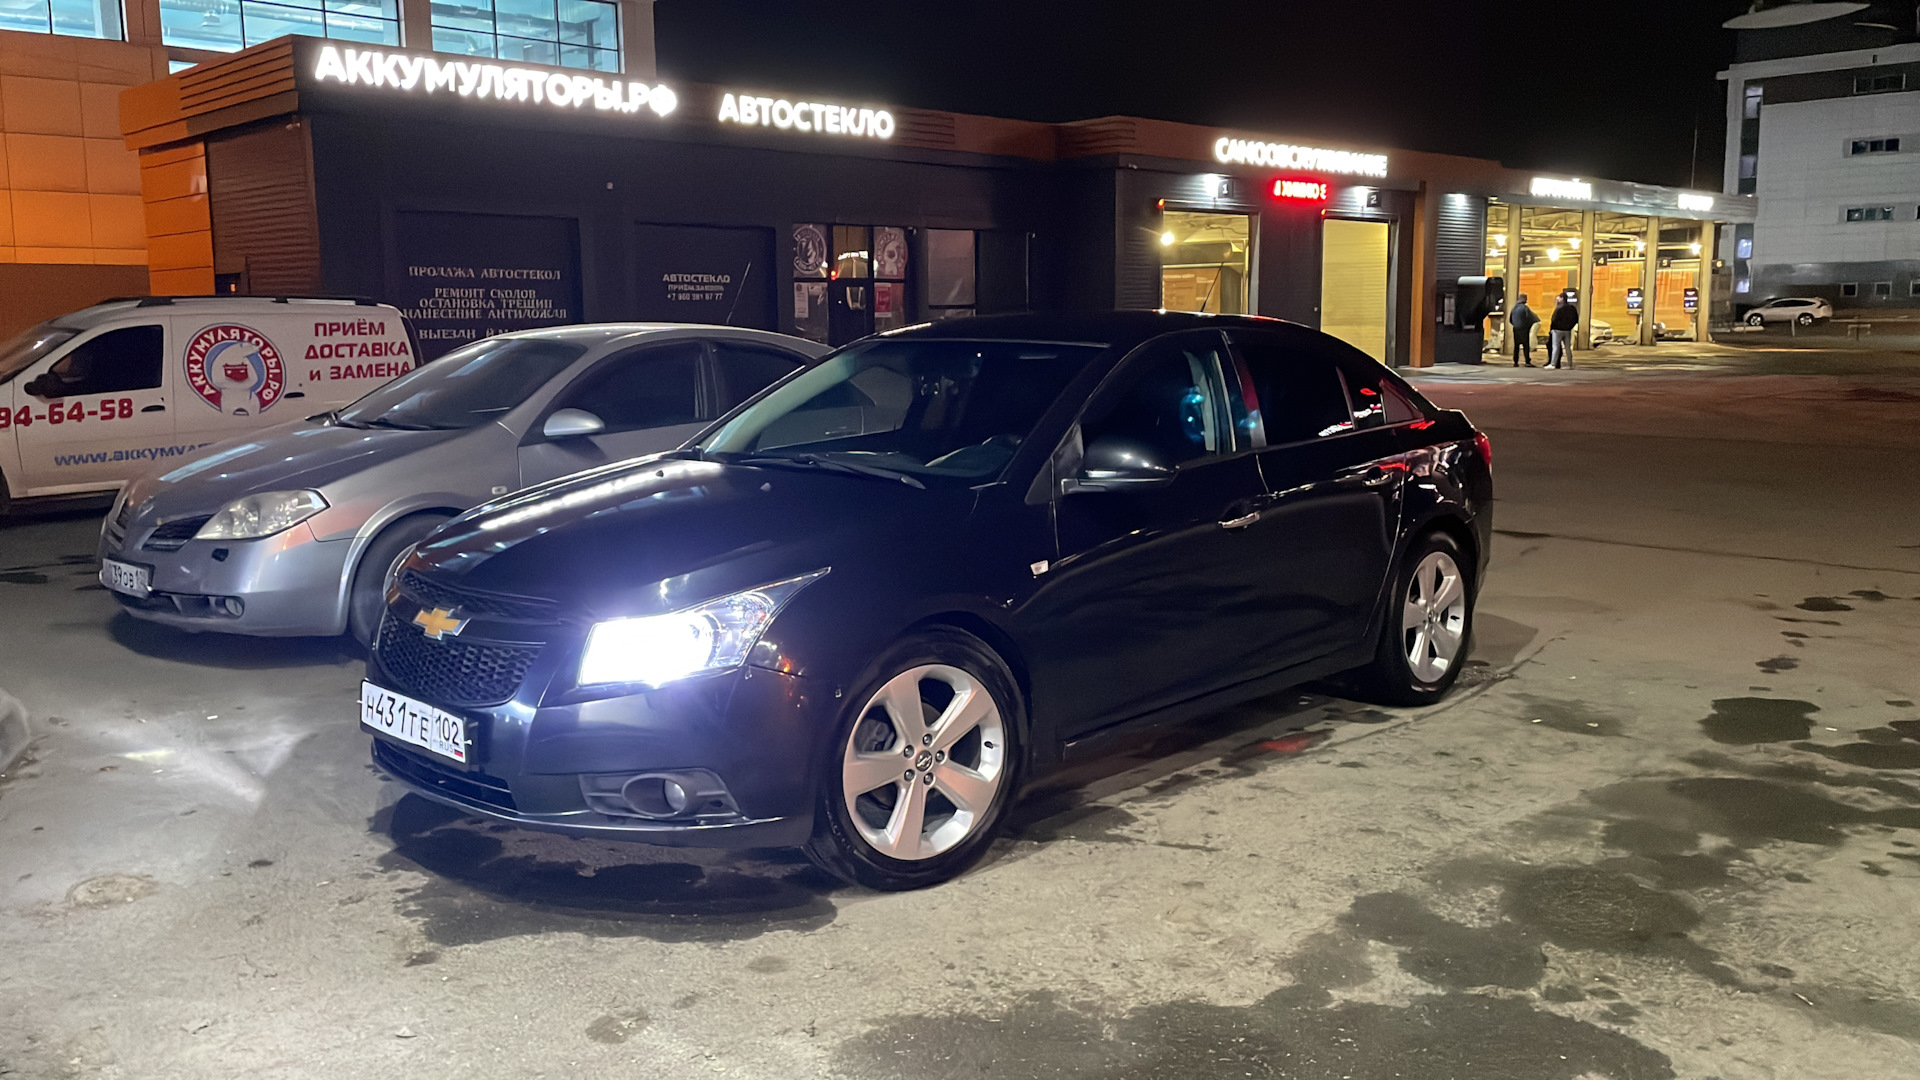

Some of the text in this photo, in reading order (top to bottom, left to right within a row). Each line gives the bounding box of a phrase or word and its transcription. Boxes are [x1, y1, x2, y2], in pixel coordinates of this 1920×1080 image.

[314, 44, 678, 117] АККУМУЛЯТОРЫ.РФ
[717, 92, 896, 140] АВТОСТЕКЛО
[1369, 194, 1378, 205] 2
[408, 265, 561, 280] ПРОДАЖА АВТОСТЕКОЛ
[662, 273, 731, 283] АВТОСТЕКЛО
[434, 287, 536, 299] РЕМОНТ СКОЛОВ
[419, 298, 553, 310] ОСТАНОВКА ТРЕЩИН
[403, 308, 482, 320] НАНЕСЕНИЕ
[314, 318, 385, 337] ПРИЁМ
[304, 341, 409, 360] ДОСТАВКА
[189, 328, 281, 401] АККУМУЛЯТОРЫ.РФ
[330, 361, 411, 380] ЗАМЕНА
[0, 398, 133, 429] 94-64-58
[435, 713, 460, 746] 102
